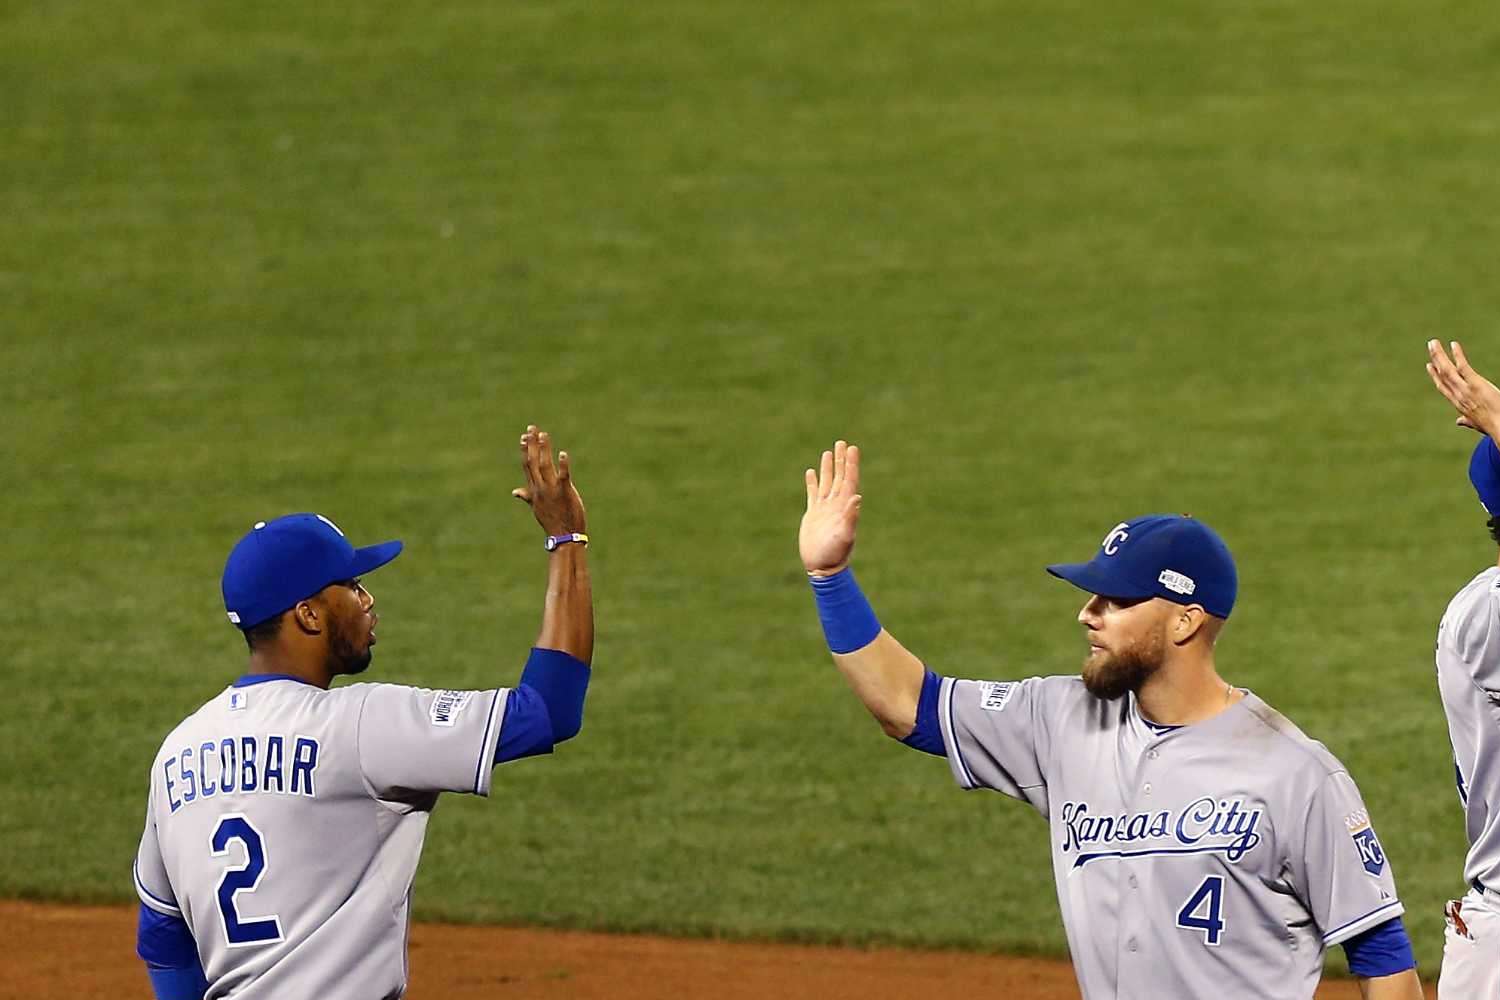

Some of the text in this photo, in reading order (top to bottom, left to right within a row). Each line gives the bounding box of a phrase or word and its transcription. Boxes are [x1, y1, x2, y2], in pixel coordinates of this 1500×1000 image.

[163, 734, 320, 814] ESCOBAR
[1062, 797, 1261, 862] Kansas City
[1355, 835, 1384, 865] KC
[210, 815, 283, 945] 2
[1177, 876, 1225, 945] 4
